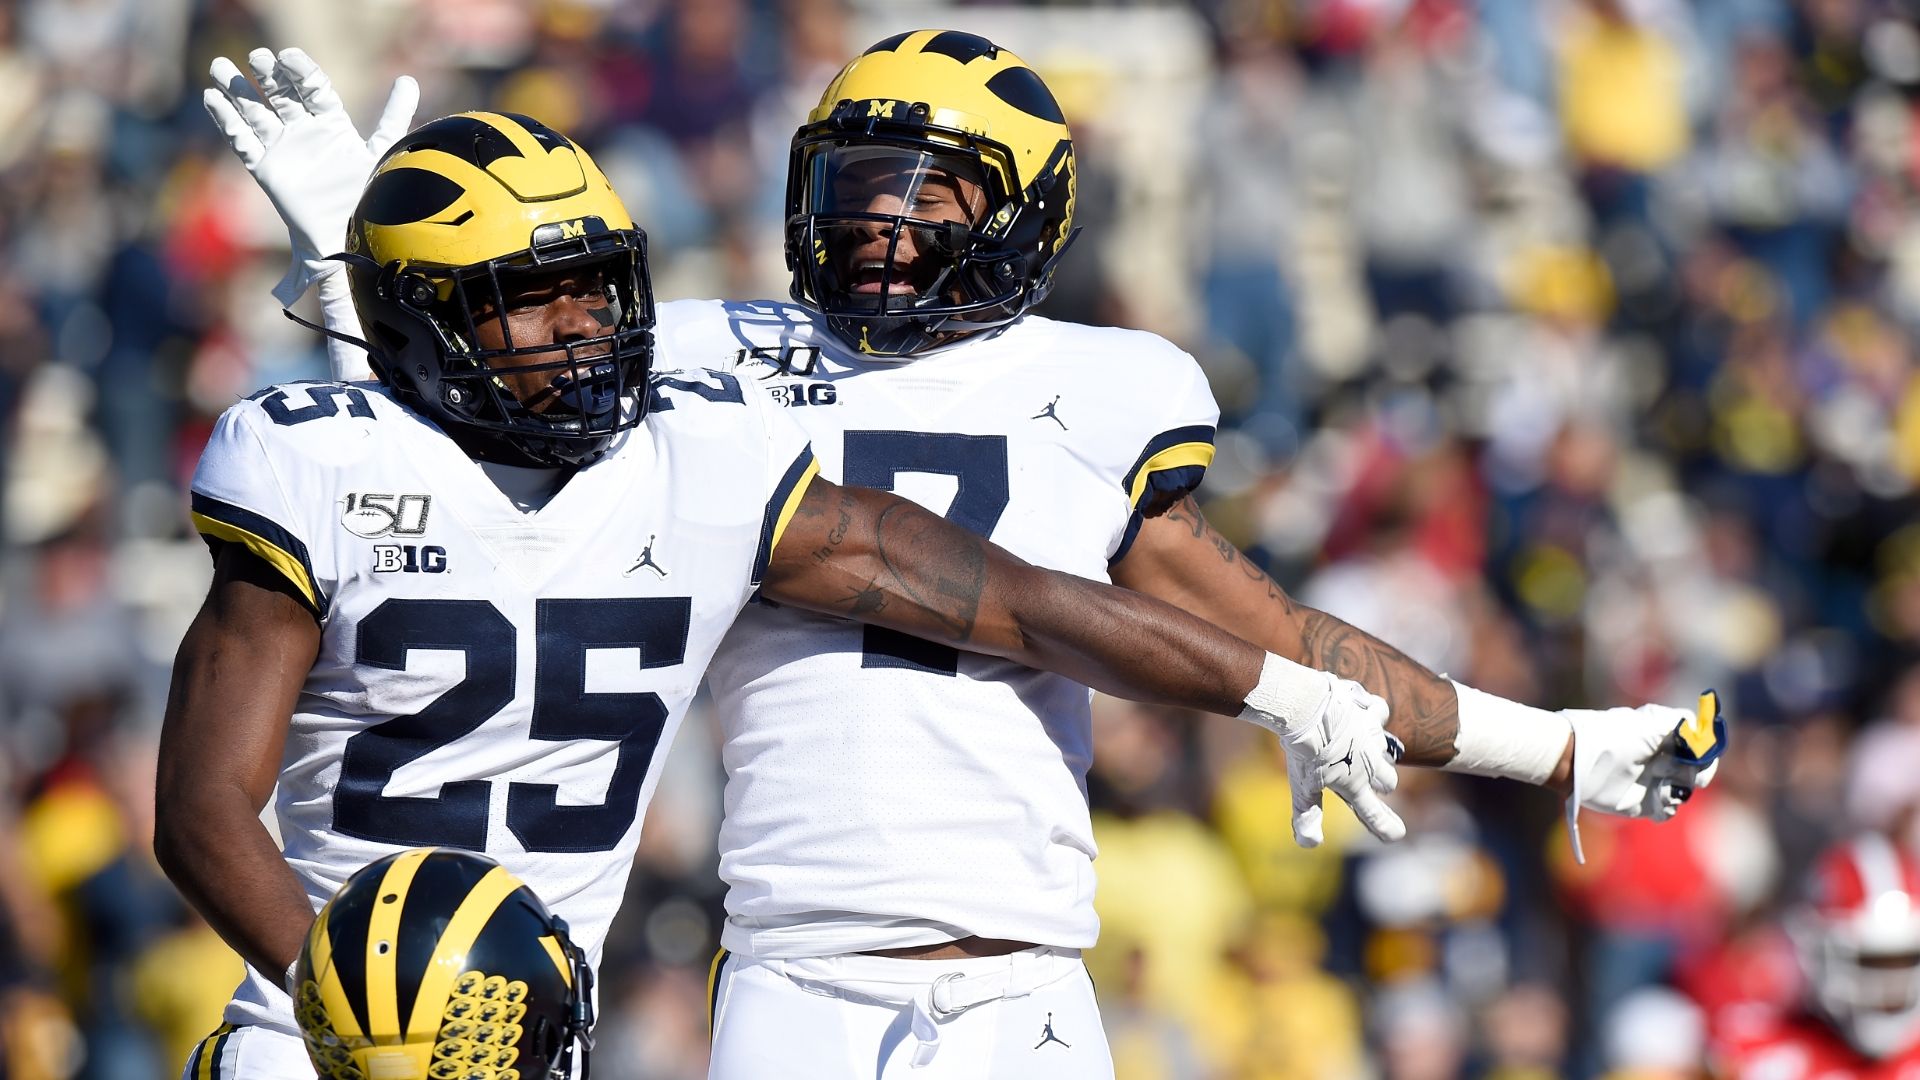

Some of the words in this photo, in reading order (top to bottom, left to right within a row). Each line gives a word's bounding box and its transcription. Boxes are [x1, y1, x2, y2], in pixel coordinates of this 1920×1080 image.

[867, 100, 895, 118] M
[560, 219, 587, 239] M
[246, 379, 378, 427] 5
[343, 493, 431, 535] 150
[843, 430, 1010, 677] 7
[331, 596, 692, 853] 25
